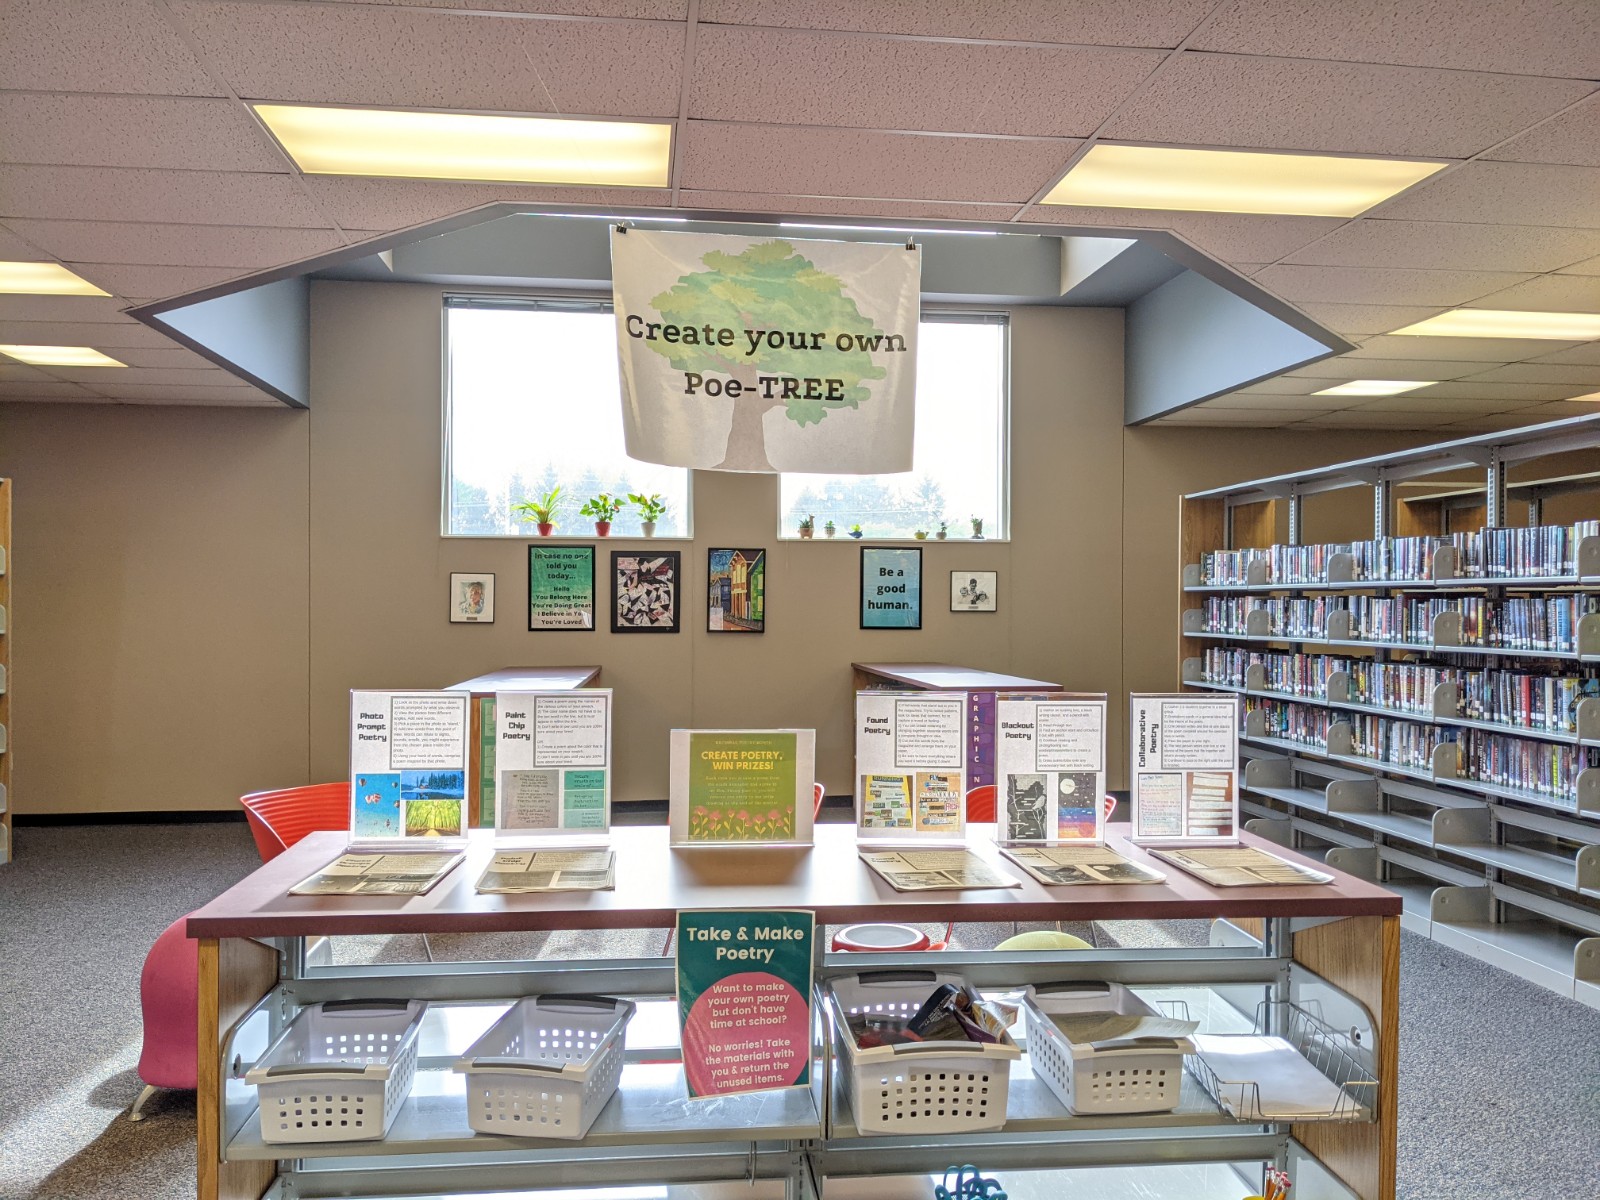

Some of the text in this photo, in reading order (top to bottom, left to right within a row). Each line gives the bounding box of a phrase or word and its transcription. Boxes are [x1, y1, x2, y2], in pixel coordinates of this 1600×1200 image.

[625, 314, 907, 356] Create your own
[684, 372, 845, 402] Poe-TREE
[879, 567, 894, 577] Be
[876, 583, 906, 595] good
[867, 600, 913, 610] human.
[360, 712, 384, 720] Photo
[505, 711, 526, 719] Paint
[357, 723, 387, 732] Prompt
[508, 721, 526, 730] Chip
[864, 727, 891, 735] Poetry
[358, 733, 387, 742] Poetry
[502, 731, 531, 741] Poetry
[1005, 732, 1032, 741] Poetry
[1149, 723, 1159, 754] Poetry
[701, 751, 783, 761] CREATE POETRY,
[712, 761, 774, 770] WIN PRIZES!
[686, 926, 804, 941] Take & Make
[716, 947, 774, 964] Poetry
[713, 982, 785, 994] Want to make
[707, 994, 790, 1008] your own poetry
[712, 1005, 786, 1017] but don't have
[710, 1015, 788, 1029] time at school?
[708, 1038, 791, 1053] No worries! Take
[705, 1049, 795, 1066] the materials with
[711, 1061, 790, 1079] you & return the
[716, 1074, 785, 1088] unused items.
